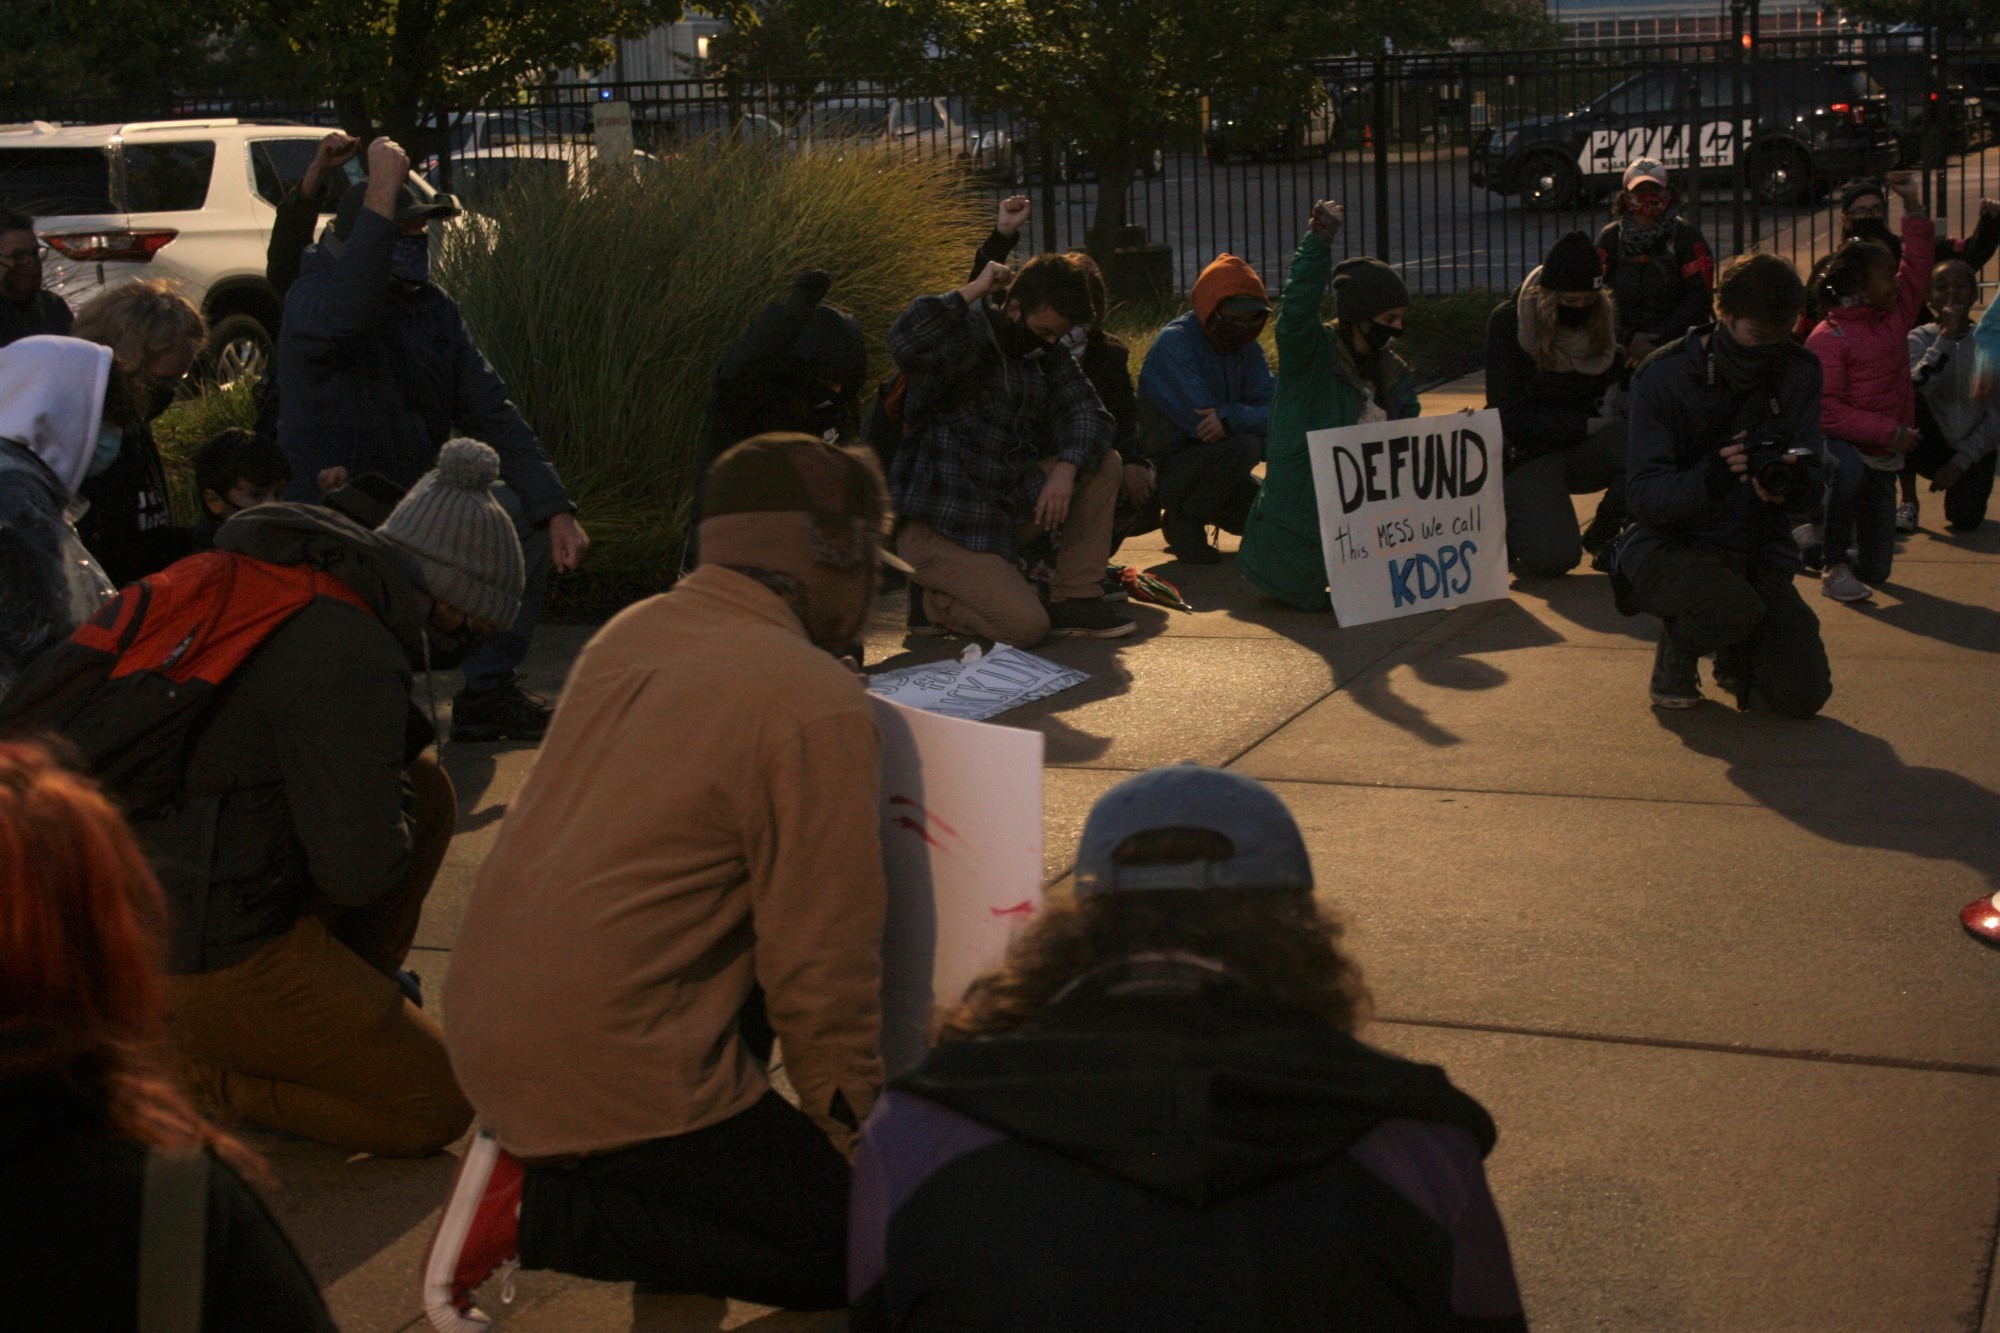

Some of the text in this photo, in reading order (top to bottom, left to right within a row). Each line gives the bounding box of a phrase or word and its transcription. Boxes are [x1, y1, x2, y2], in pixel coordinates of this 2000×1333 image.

[1332, 428, 1489, 514] DEFUND
[1335, 521, 1369, 563] this
[1377, 518, 1415, 548] MESS
[1388, 540, 1478, 608] KDPS
